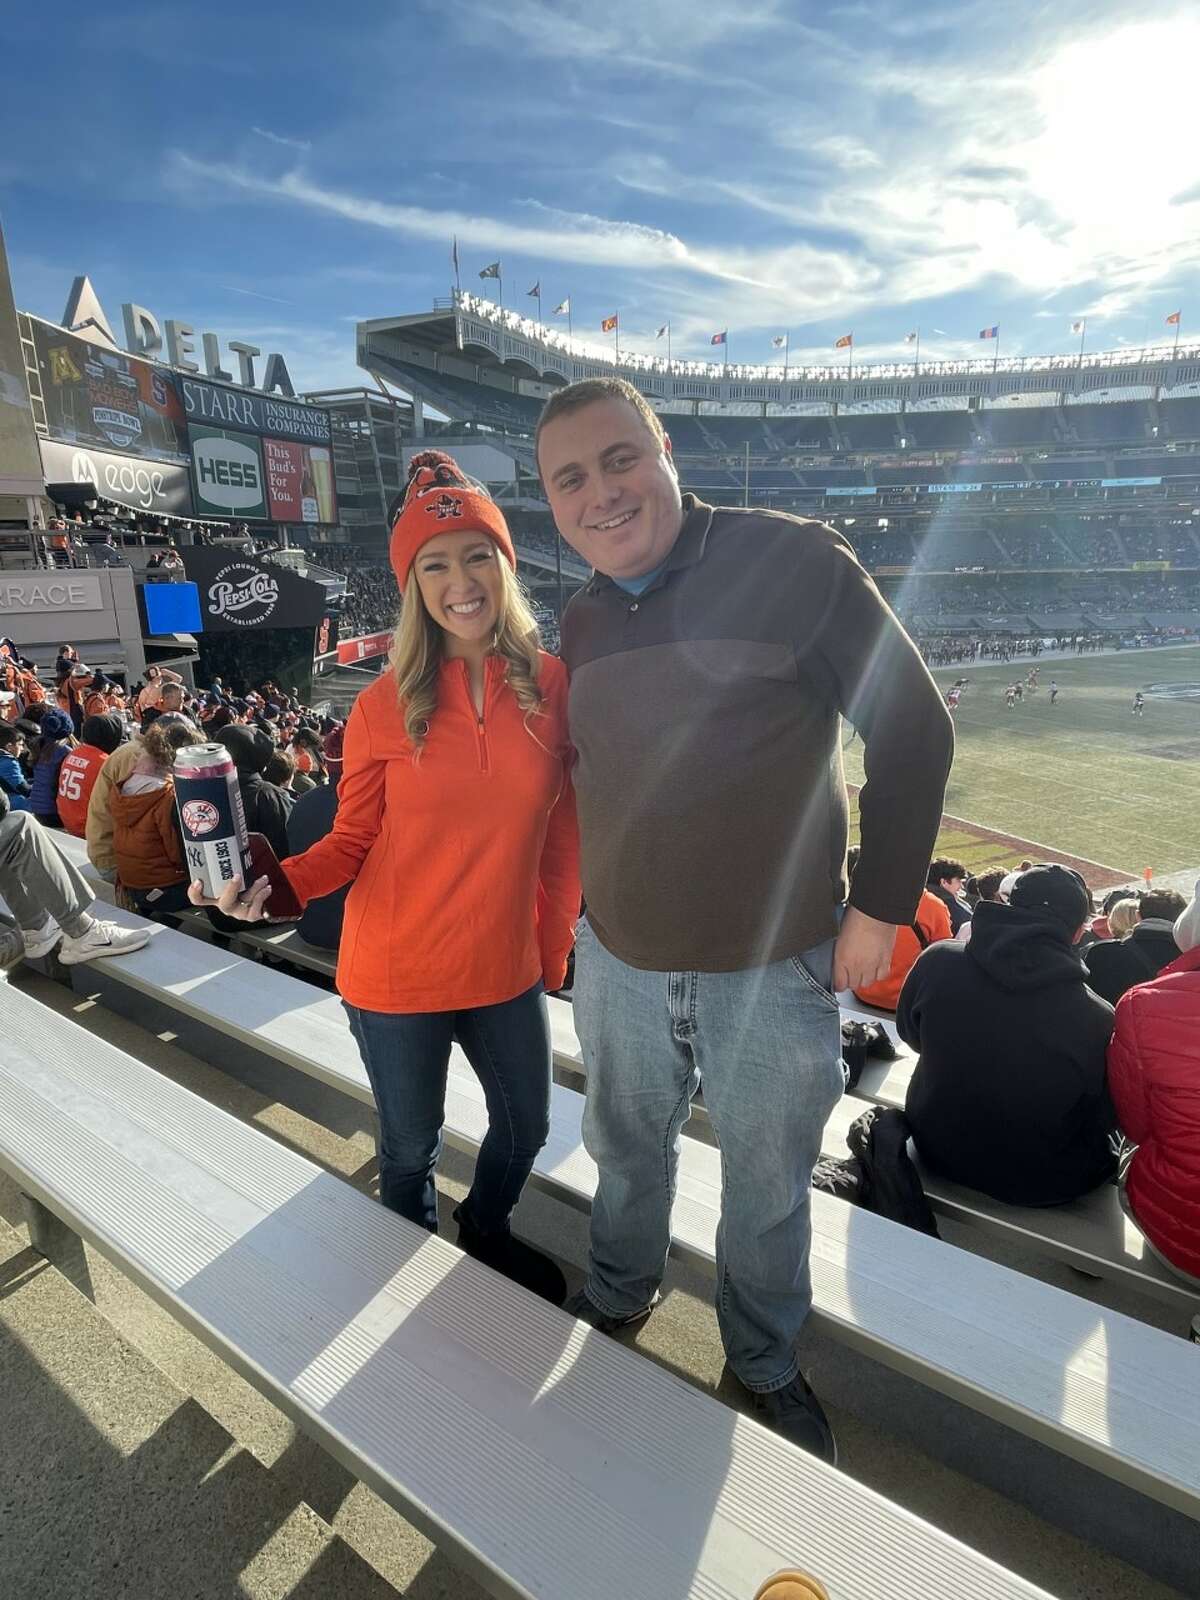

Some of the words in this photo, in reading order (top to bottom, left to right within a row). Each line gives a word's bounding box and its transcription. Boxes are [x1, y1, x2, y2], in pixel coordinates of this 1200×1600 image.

[122, 303, 296, 398] DELTA
[183, 382, 260, 427] STARR
[265, 402, 330, 426] INSURANCE
[267, 417, 331, 439] COMPANIES
[266, 443, 291, 459] This
[198, 457, 259, 489] HESS
[268, 458, 297, 474] Bud's
[105, 462, 167, 508] edge
[270, 473, 288, 487] For
[271, 487, 295, 503] You.
[0, 583, 87, 606] RACE
[59, 768, 85, 800] 35
[215, 841, 231, 860] 1903
[219, 858, 235, 881] SINCE
